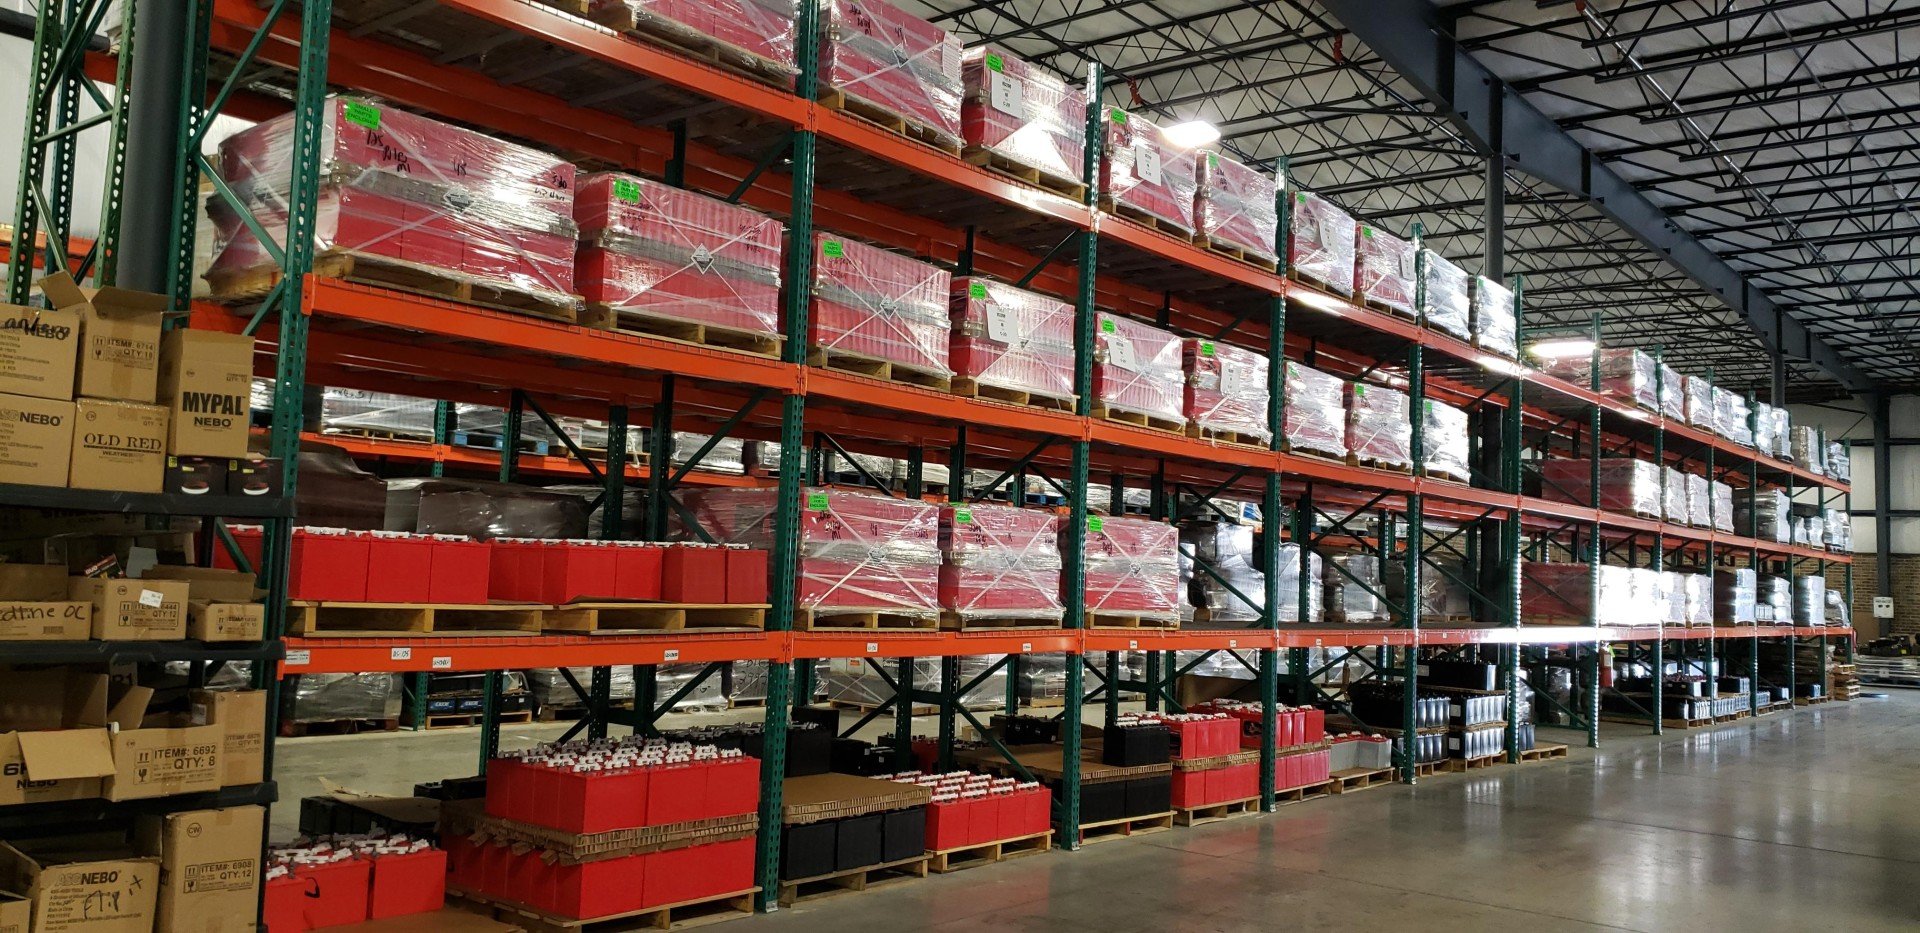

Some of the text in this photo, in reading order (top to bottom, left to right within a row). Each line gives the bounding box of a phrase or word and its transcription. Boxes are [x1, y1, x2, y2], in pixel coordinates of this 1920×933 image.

[183, 391, 244, 416] MYPAL
[19, 411, 61, 427] NEBO
[194, 416, 232, 428] NEBO
[84, 432, 162, 451] OLD RED
[192, 744, 216, 756] 6692
[173, 755, 216, 770] QTY: 8
[80, 870, 119, 885] NEBO
[242, 869, 252, 878] 12
